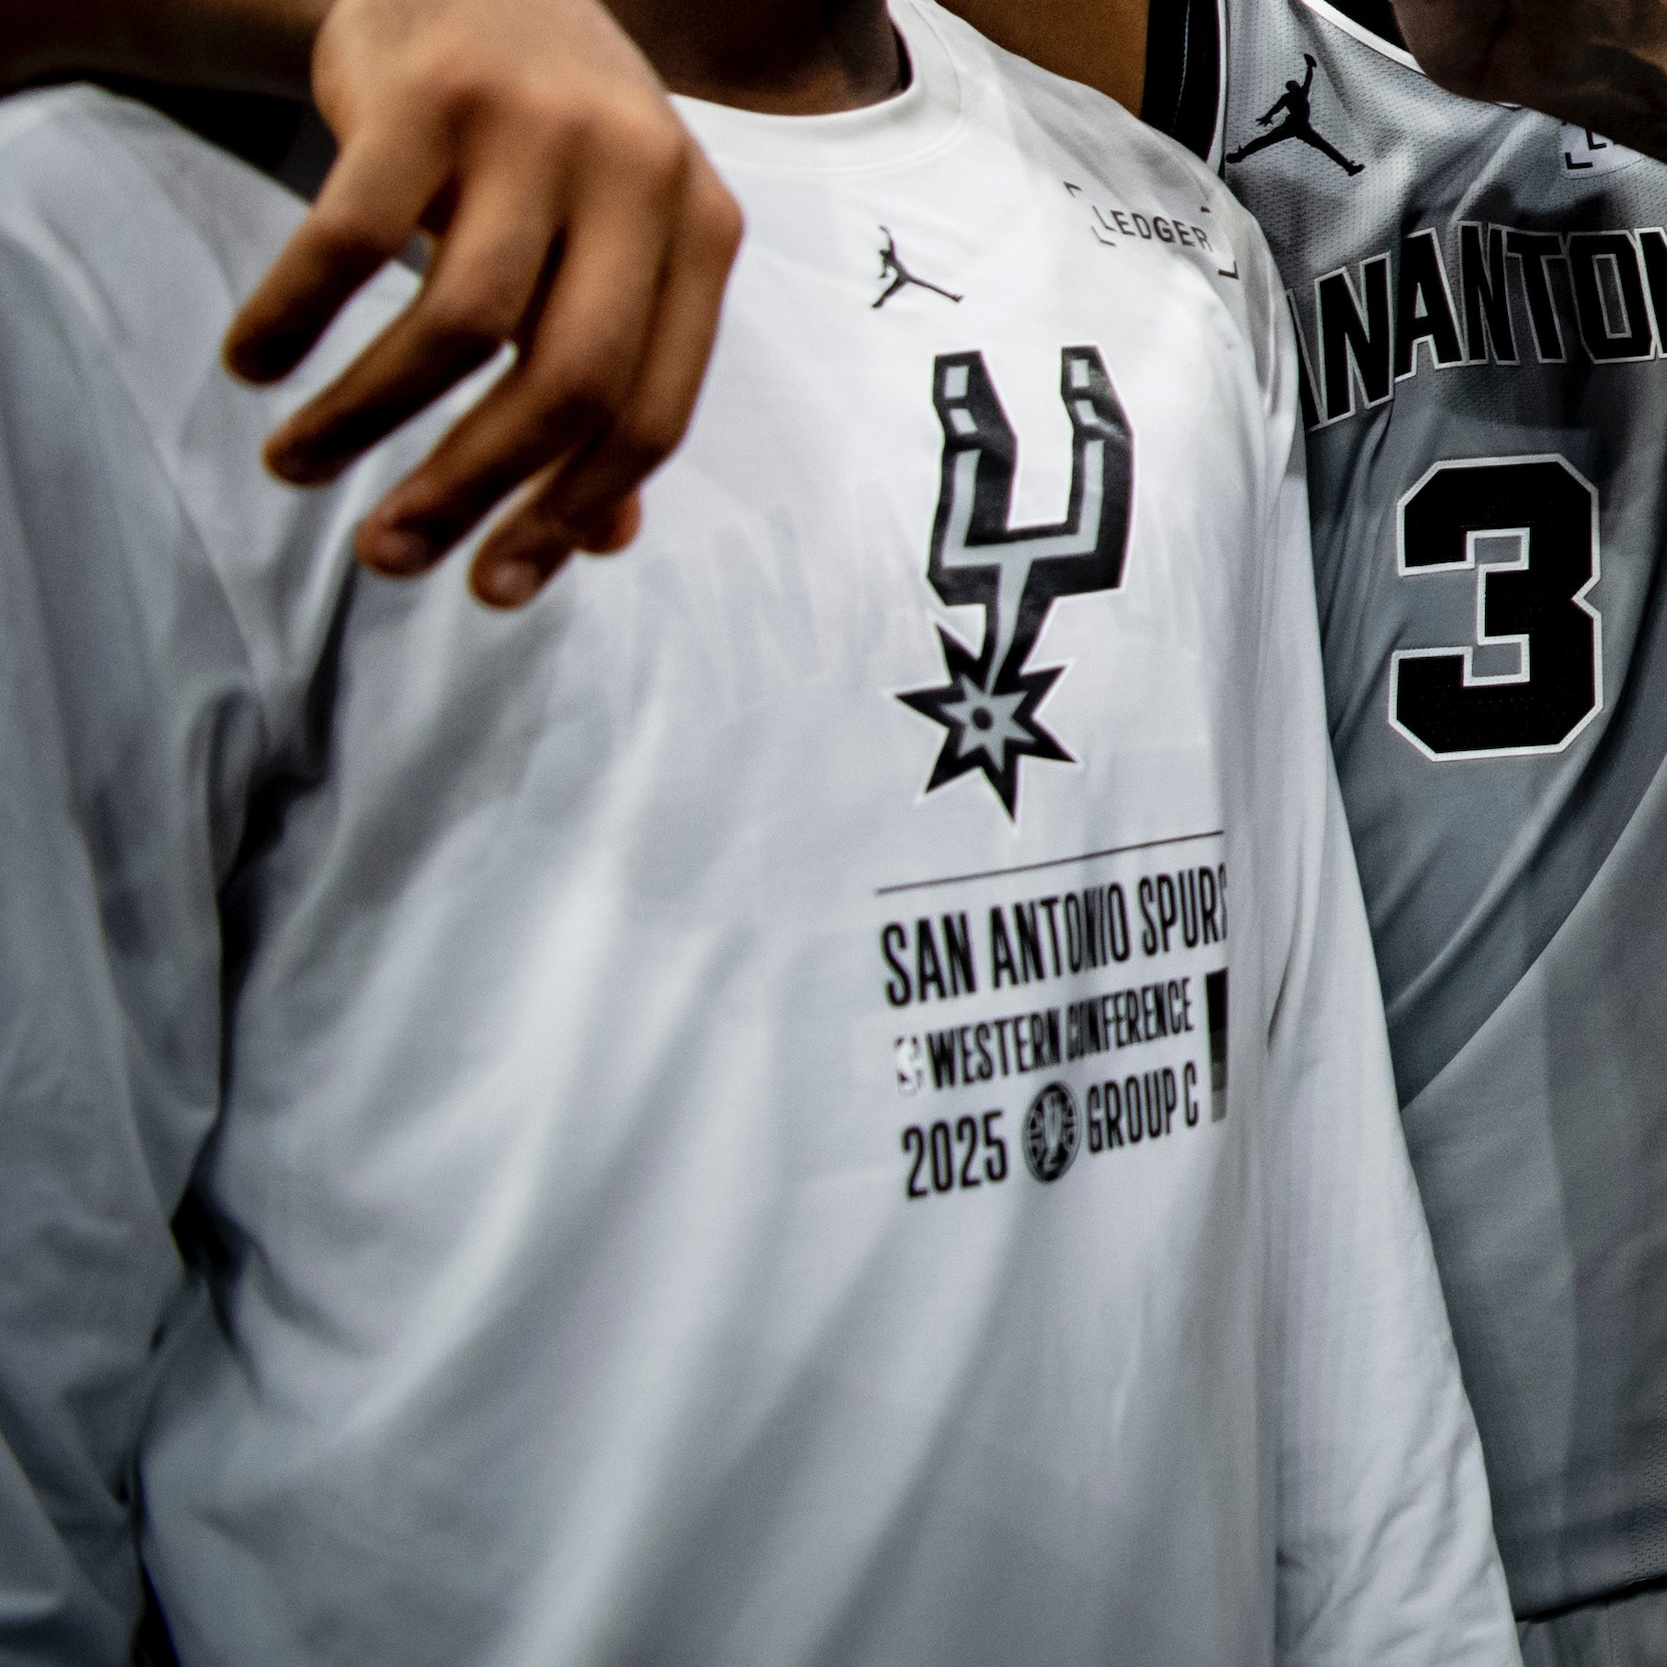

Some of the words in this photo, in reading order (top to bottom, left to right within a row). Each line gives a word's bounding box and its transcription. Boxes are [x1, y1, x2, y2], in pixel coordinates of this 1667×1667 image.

[1092, 205, 1214, 252] LEDGER
[1388, 453, 1604, 763] 3
[881, 909, 978, 1009] SAN
[989, 881, 1132, 990] ANTONIO
[925, 1007, 1062, 1091] WESTERN
[1066, 976, 1195, 1062] CONFERENCE
[903, 1109, 1009, 1201] 2025
[1086, 1066, 1176, 1155] GROUP
[1182, 1060, 1199, 1129] C
